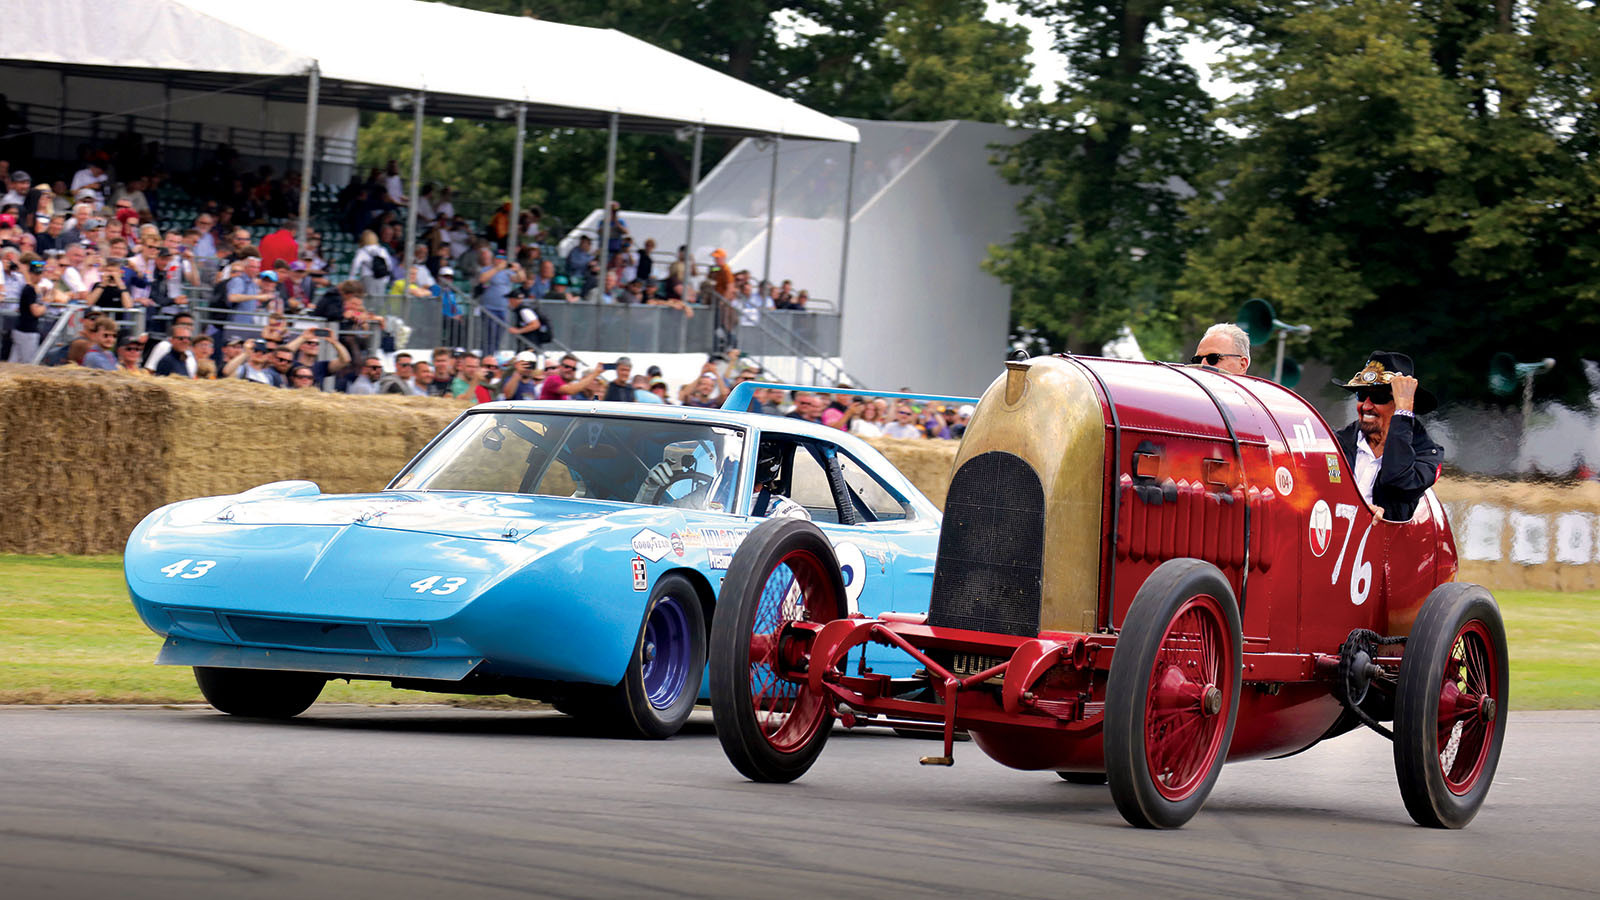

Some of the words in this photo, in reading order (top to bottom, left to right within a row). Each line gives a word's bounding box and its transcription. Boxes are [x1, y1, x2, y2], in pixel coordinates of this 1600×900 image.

[633, 538, 670, 551] GOODYEAR
[1331, 502, 1374, 606] 76
[160, 558, 217, 579] 43
[409, 574, 468, 596] 43
